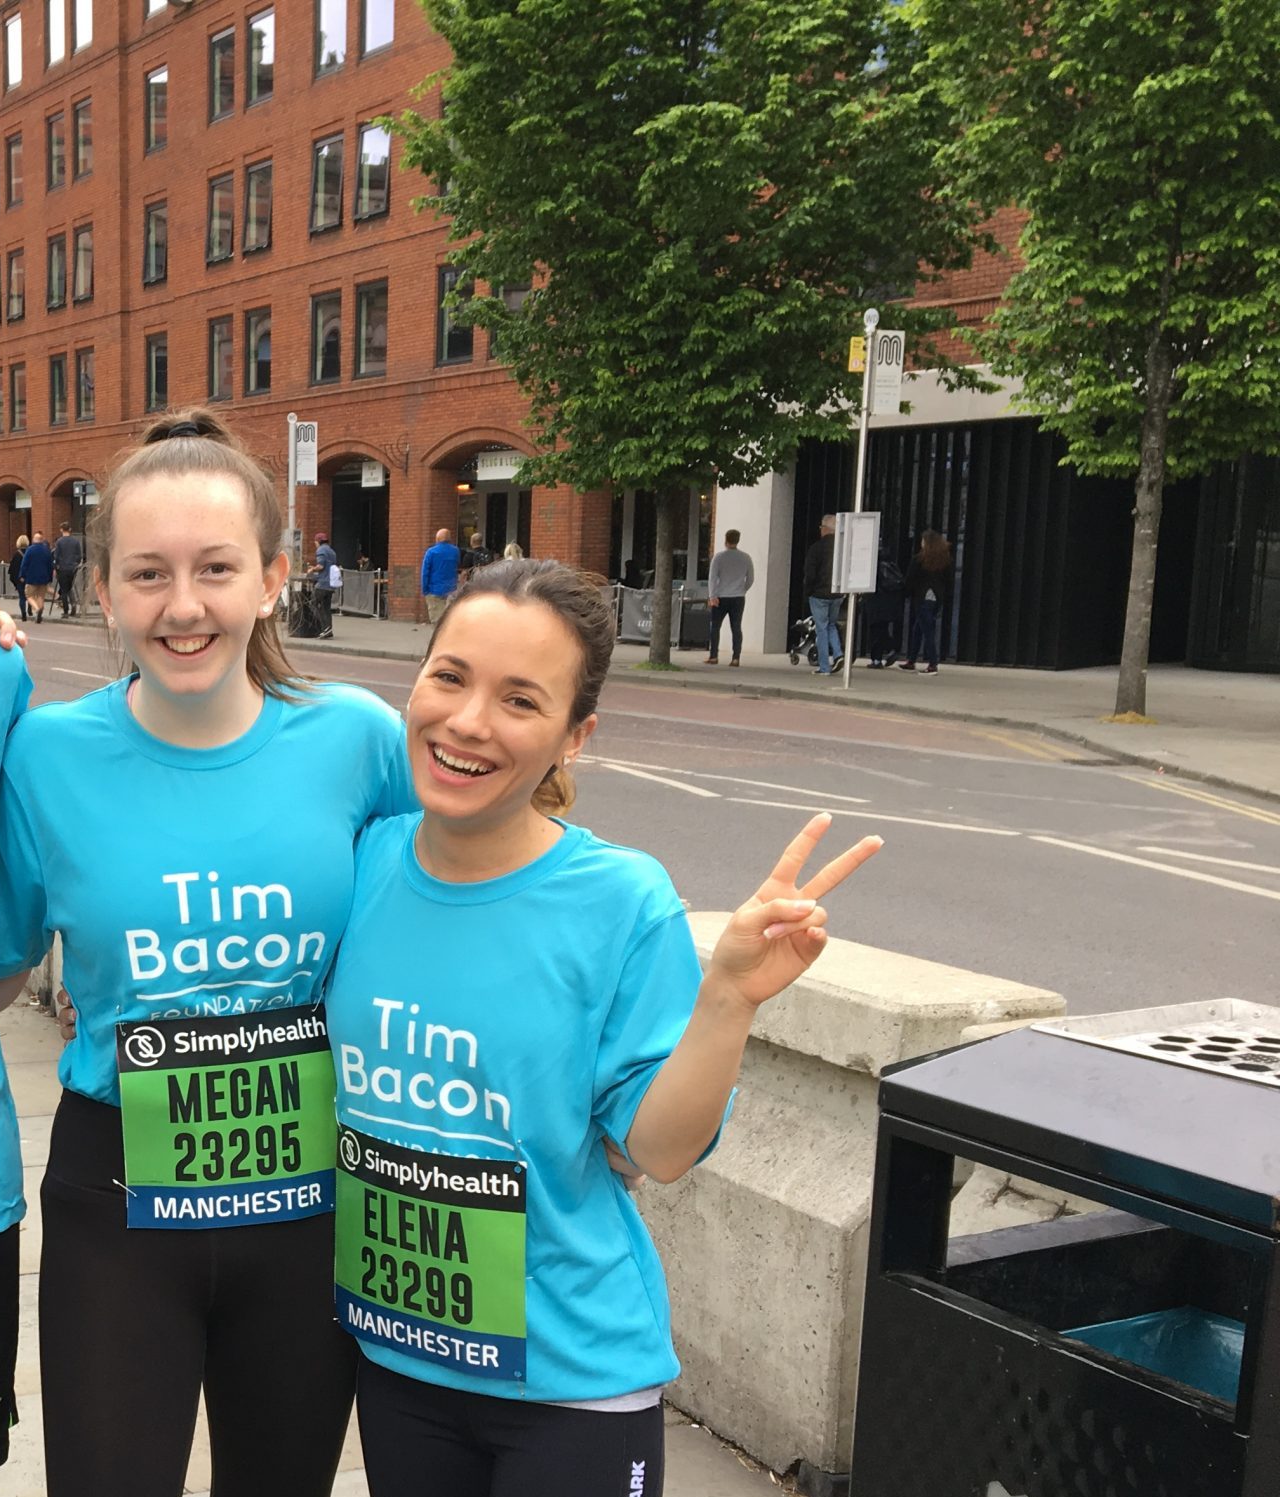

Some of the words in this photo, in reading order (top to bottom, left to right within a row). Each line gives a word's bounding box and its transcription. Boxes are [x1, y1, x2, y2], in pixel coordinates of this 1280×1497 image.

[162, 870, 293, 924] Tim
[125, 928, 326, 981] Bacon
[173, 1016, 327, 1055] Simplyhealth
[372, 997, 478, 1068] Tim
[167, 1061, 301, 1124] MEGAN
[340, 1043, 511, 1131] Bacon
[174, 1121, 301, 1182] 23295
[365, 1149, 519, 1197] Simplyhealth
[154, 1183, 322, 1219] MANCHESTER
[364, 1188, 469, 1264] ELENA
[361, 1246, 473, 1325] 23299
[348, 1302, 499, 1368] MANCHESTER
